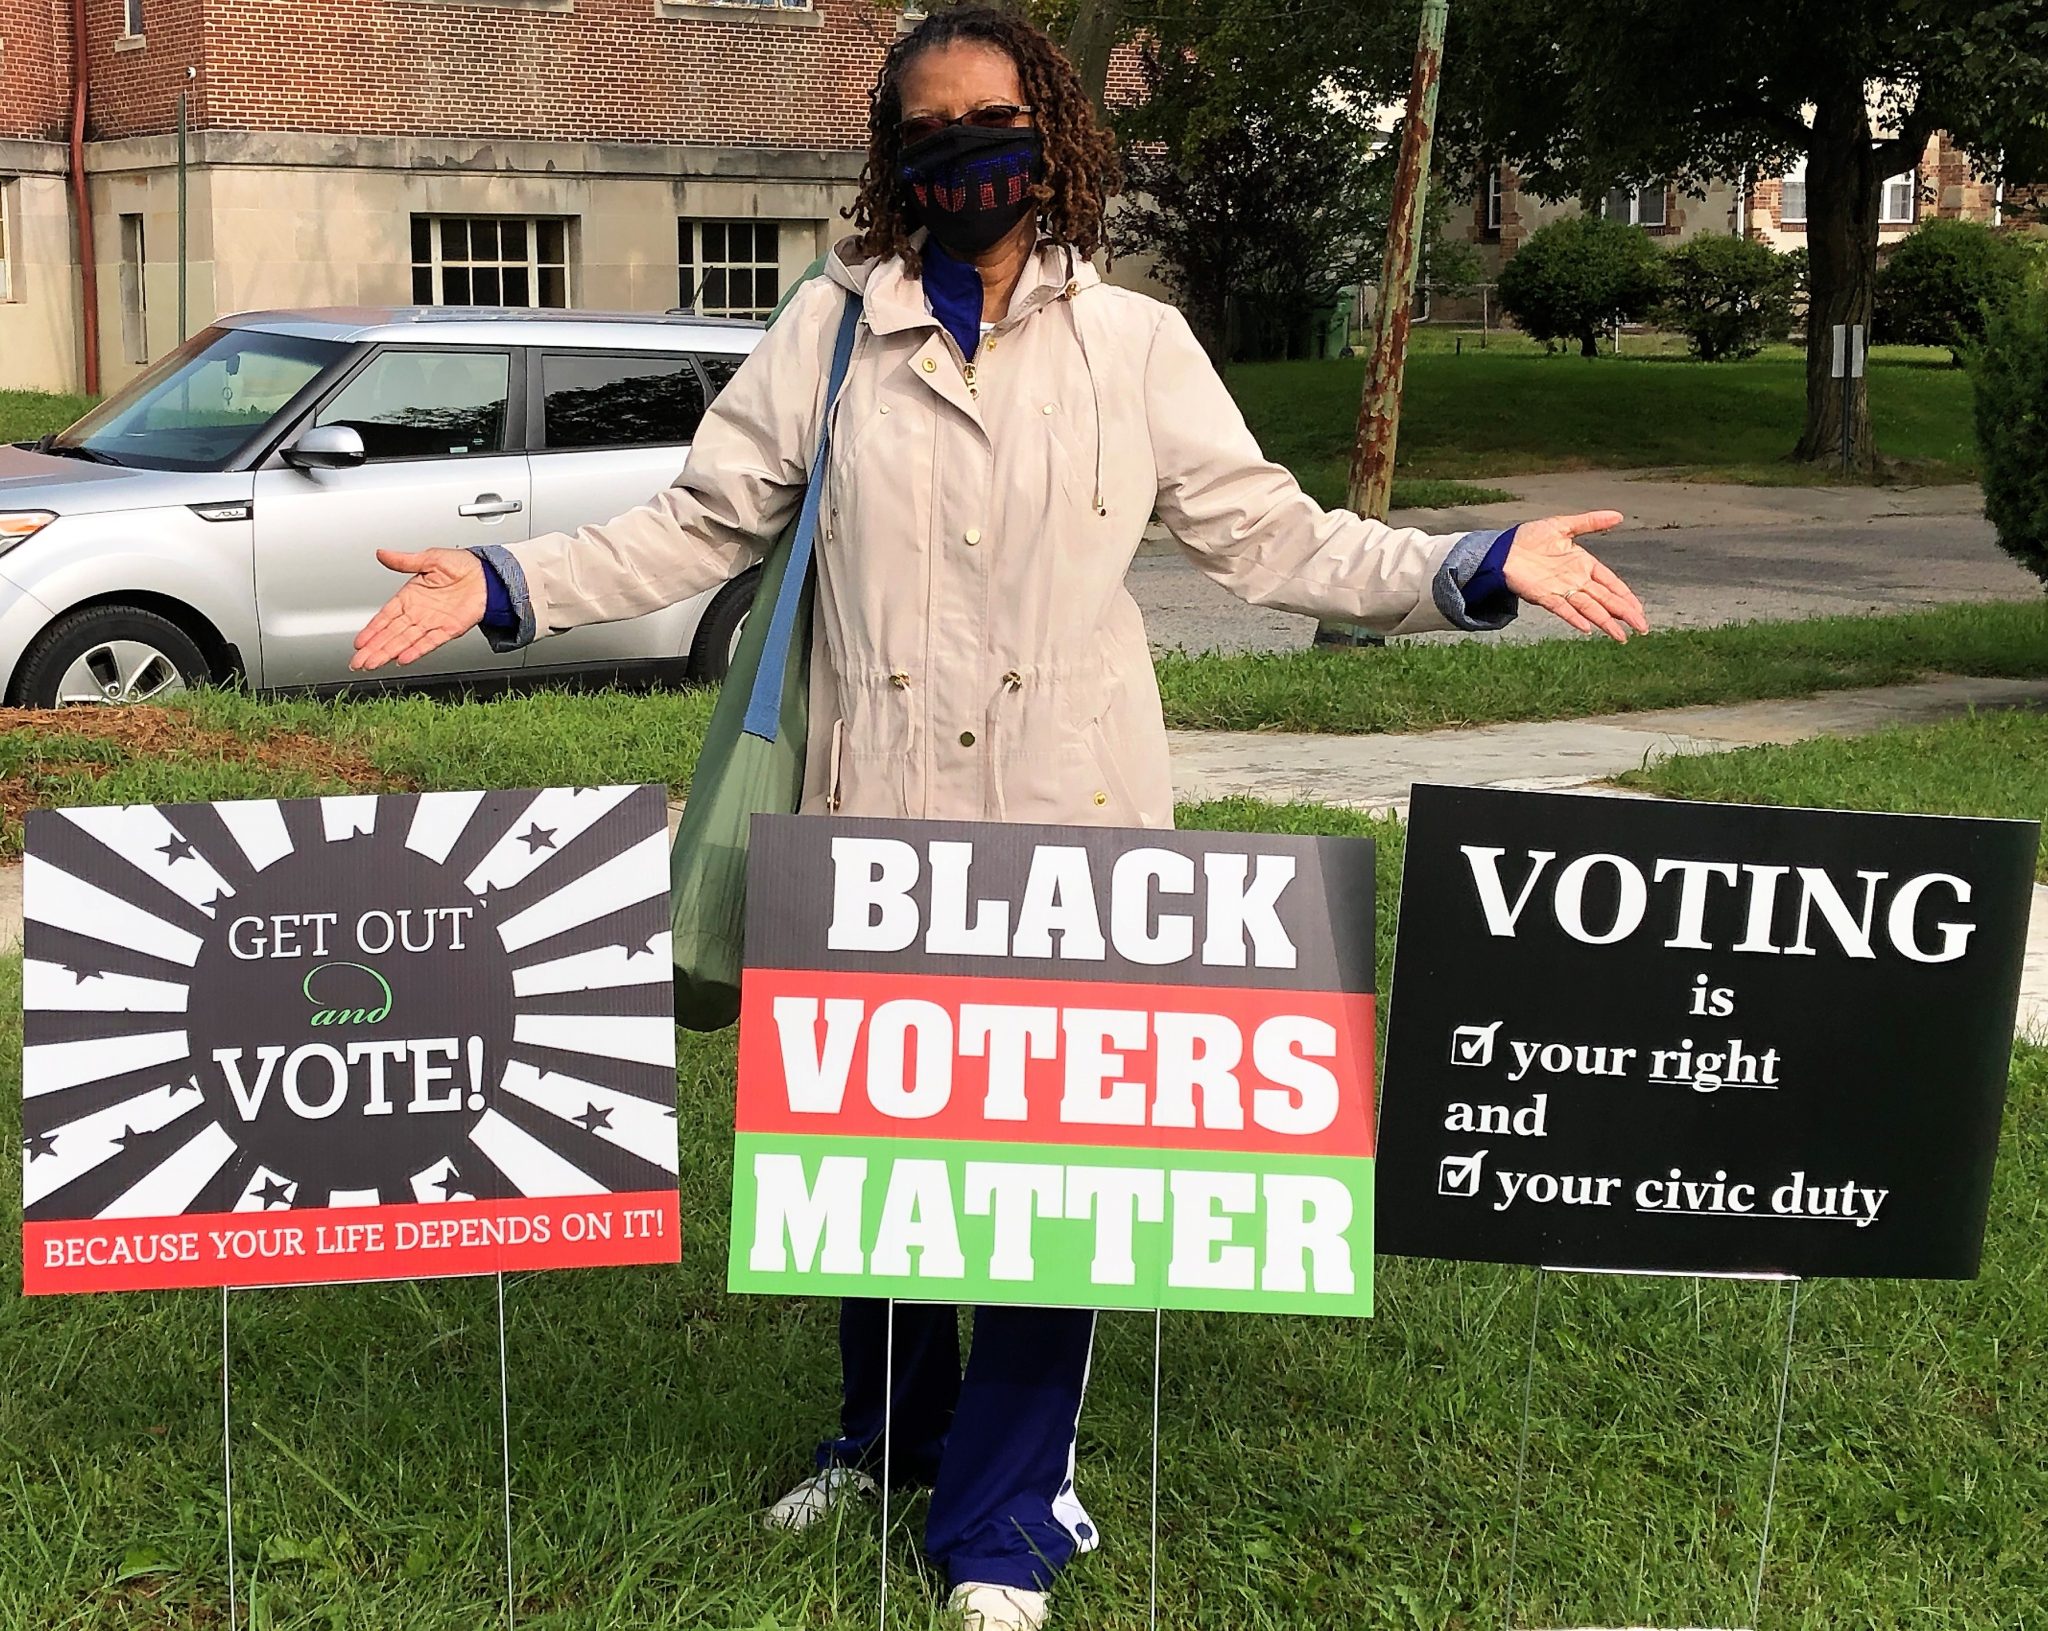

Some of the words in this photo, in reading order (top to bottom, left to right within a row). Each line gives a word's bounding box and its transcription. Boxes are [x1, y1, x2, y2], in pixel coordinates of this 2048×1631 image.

[228, 912, 337, 960] GET
[356, 907, 473, 953] OUT
[827, 837, 1297, 969] BLACK
[1460, 845, 1976, 963] VOTING
[303, 961, 393, 1027] and
[1689, 974, 1734, 1016] is
[212, 1035, 486, 1122] VOTE!
[773, 996, 1340, 1135] VOTERS
[1508, 1041, 1636, 1081] your
[1649, 1039, 1781, 1092] right
[1444, 1094, 1548, 1136] and
[749, 1153, 1355, 1295] MATTER
[1494, 1172, 1621, 1210] your
[1635, 1169, 1755, 1213] civic
[1772, 1172, 1889, 1227] duty
[43, 1232, 199, 1268] BECAUSE
[208, 1228, 306, 1259] YOUR
[316, 1223, 385, 1254] LIFE
[394, 1214, 551, 1250] DEPENDS
[562, 1211, 613, 1240] ON
[623, 1209, 664, 1238] IT!
